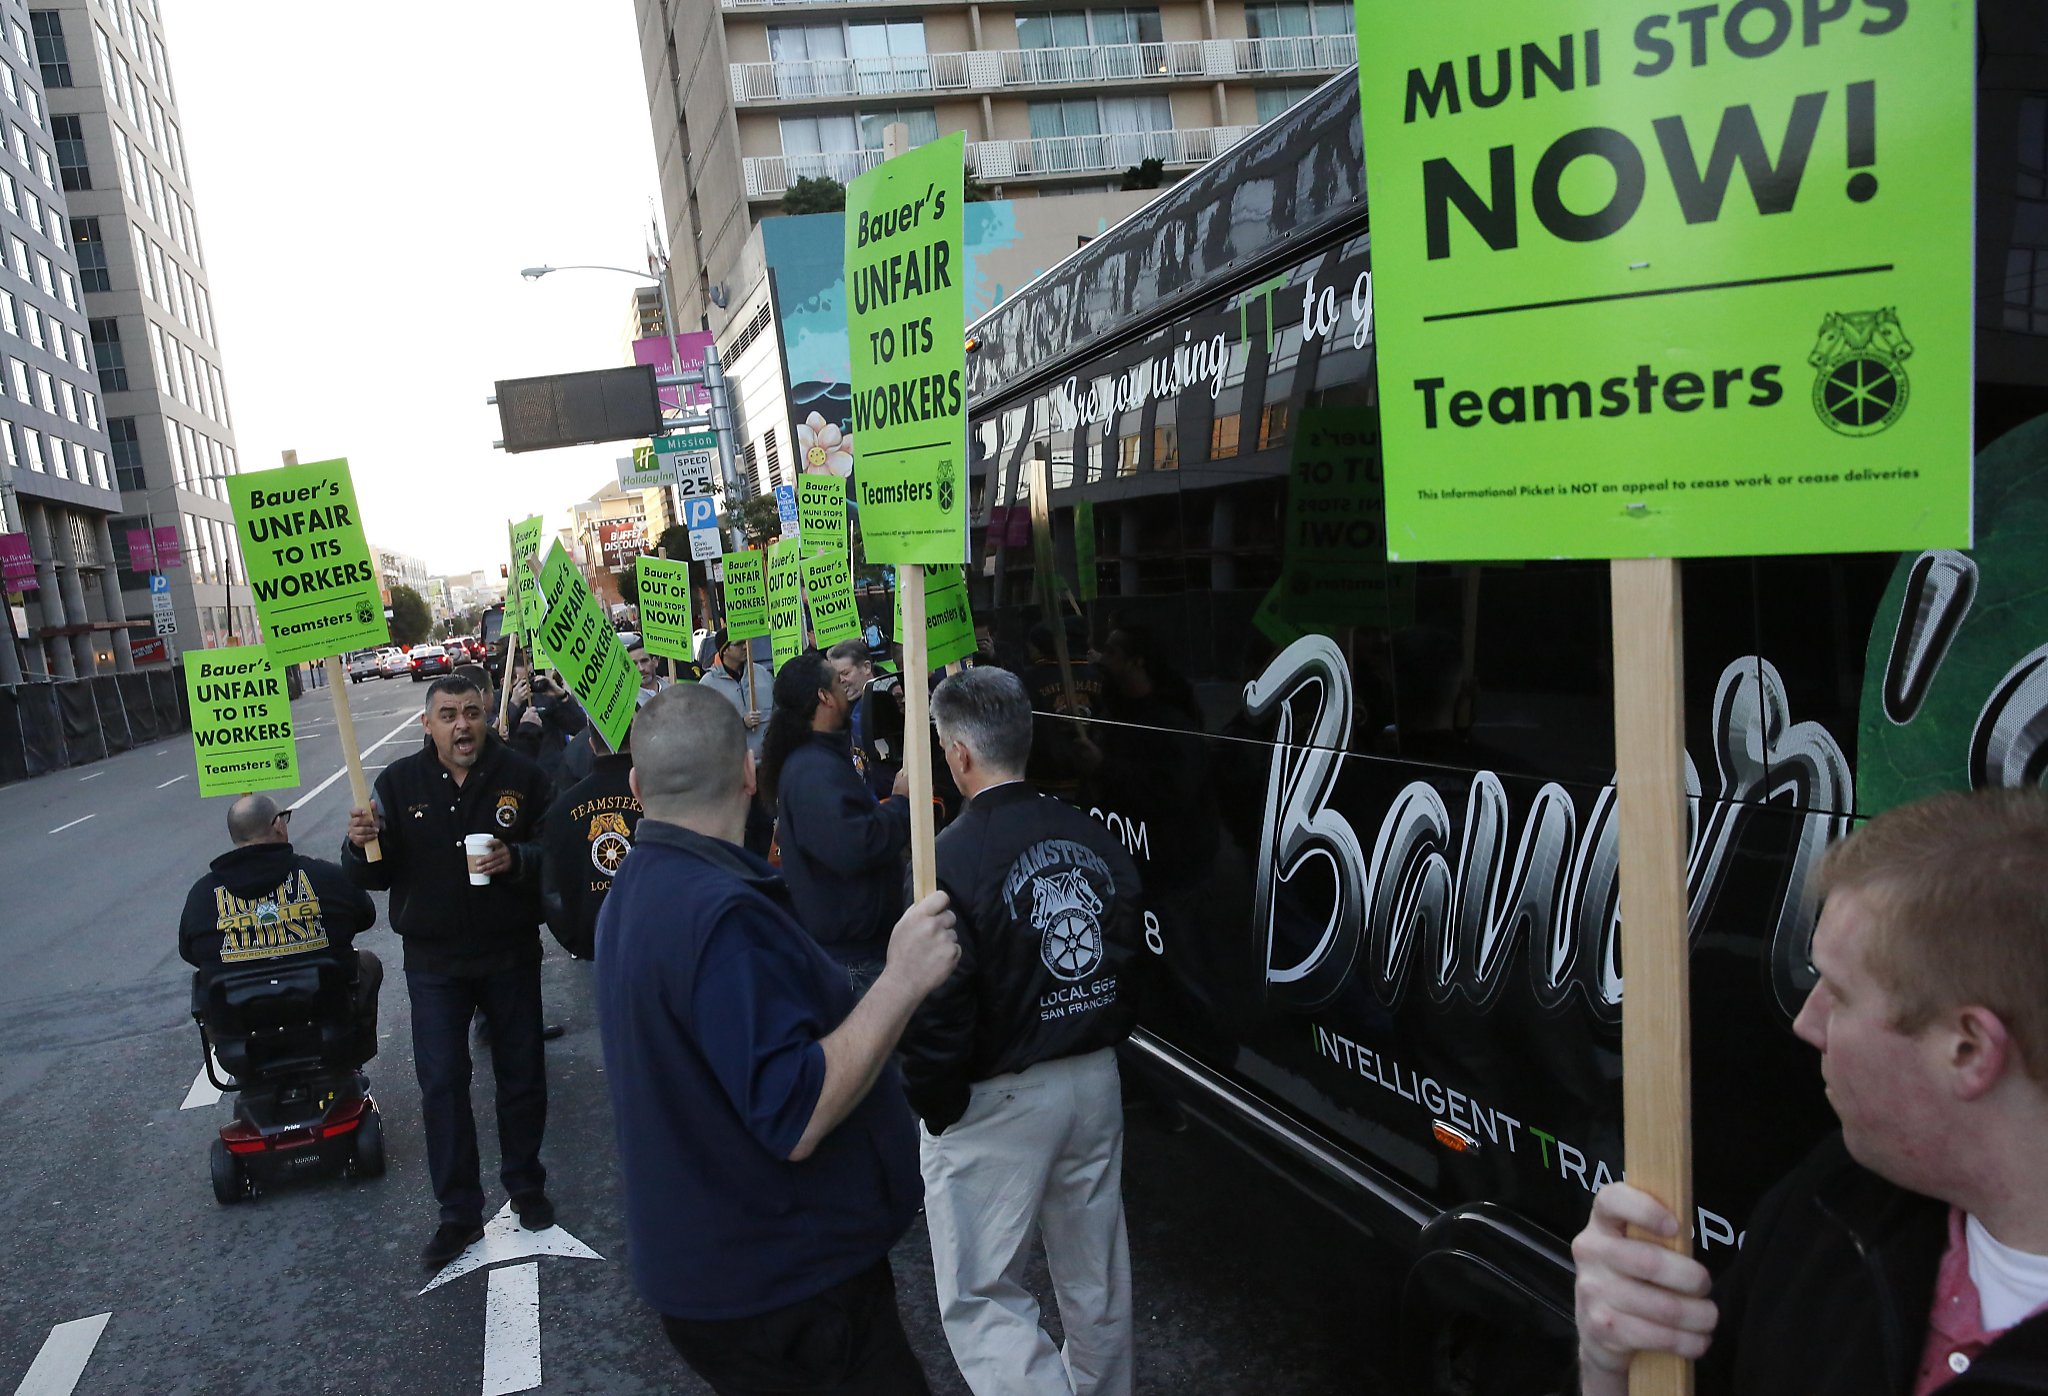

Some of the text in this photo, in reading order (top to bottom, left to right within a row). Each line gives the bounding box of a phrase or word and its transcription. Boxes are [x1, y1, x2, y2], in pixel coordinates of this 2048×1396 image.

[1403, 0, 1909, 125] MUNI STOPS
[1422, 78, 1879, 261] NOW!
[857, 182, 946, 248] Bauer's
[853, 239, 952, 315] UNFAIR
[870, 316, 934, 365] TO ITS
[1061, 376, 1099, 432] Are
[1104, 365, 1150, 436] you
[1151, 330, 1228, 400] using
[1302, 276, 1340, 342] to
[853, 369, 961, 433] WORKERS
[1414, 362, 1784, 430] Teamsters
[668, 435, 712, 450] Mission
[677, 456, 708, 467] SPEED
[623, 471, 675, 487] Holiday Inn
[681, 466, 705, 477] LIMIT
[681, 477, 709, 496] 25
[805, 481, 840, 492] Bauer's
[862, 479, 933, 506] Teamsters
[1418, 467, 1920, 500] This Informational Picket is NOT an appeal to cease work or cease deliveries
[251, 478, 340, 509] Bauer's
[801, 493, 844, 506] OUT OF
[248, 504, 352, 543] UNFAIR
[804, 518, 841, 530] NOW!
[515, 526, 538, 544] Bauer's
[610, 530, 640, 541] BUFFET
[803, 538, 835, 547] Teamsters
[272, 538, 342, 566] TO ITS
[604, 539, 650, 552] DISCOUNTS
[729, 559, 758, 570] Bauer's
[771, 551, 795, 570] Bauer's
[809, 559, 842, 577] Bauer's
[253, 560, 372, 602] WORKERS
[644, 566, 681, 581] Bauer's
[727, 570, 760, 585] UNFAIR
[769, 571, 797, 592] OUT OF
[808, 572, 848, 592] OUT OF
[641, 580, 686, 598] OUT OF
[734, 585, 756, 596] TO ITS
[812, 588, 850, 604] MUNI STOPS
[643, 598, 686, 612] MUNI STOPS
[726, 596, 765, 611] WORKERS
[781, 594, 797, 607] STOPS
[815, 597, 852, 618] NOW!
[271, 612, 353, 638] Teamsters
[547, 579, 587, 653] UNFAIR
[646, 609, 685, 627] NOW!
[730, 618, 758, 628] Teamsters
[772, 609, 797, 631] NOW!
[926, 606, 958, 630] eamsters
[158, 623, 176, 634] 25
[570, 612, 596, 662] TO ITS
[818, 622, 849, 636] Teamsters
[646, 632, 679, 645] Teamsters
[200, 658, 271, 678] Bauer's
[574, 618, 614, 702] WORKERS
[197, 678, 280, 702] UNFAIR
[600, 671, 626, 726] Teamsters
[212, 704, 268, 721] TO ITS
[195, 722, 291, 747] WORKERS
[205, 760, 271, 774] Teamsters
[570, 796, 644, 821] TEAMSTERS
[591, 881, 612, 892] LOC
[1001, 839, 1116, 920] TEAMSTERS
[1144, 910, 1164, 956] 8
[1040, 985, 1090, 1007] LOCAL
[1041, 1007, 1065, 1021] SAN
[1312, 1022, 1520, 1153] INTELLIGENT
[284, 1124, 300, 1132] Pride
